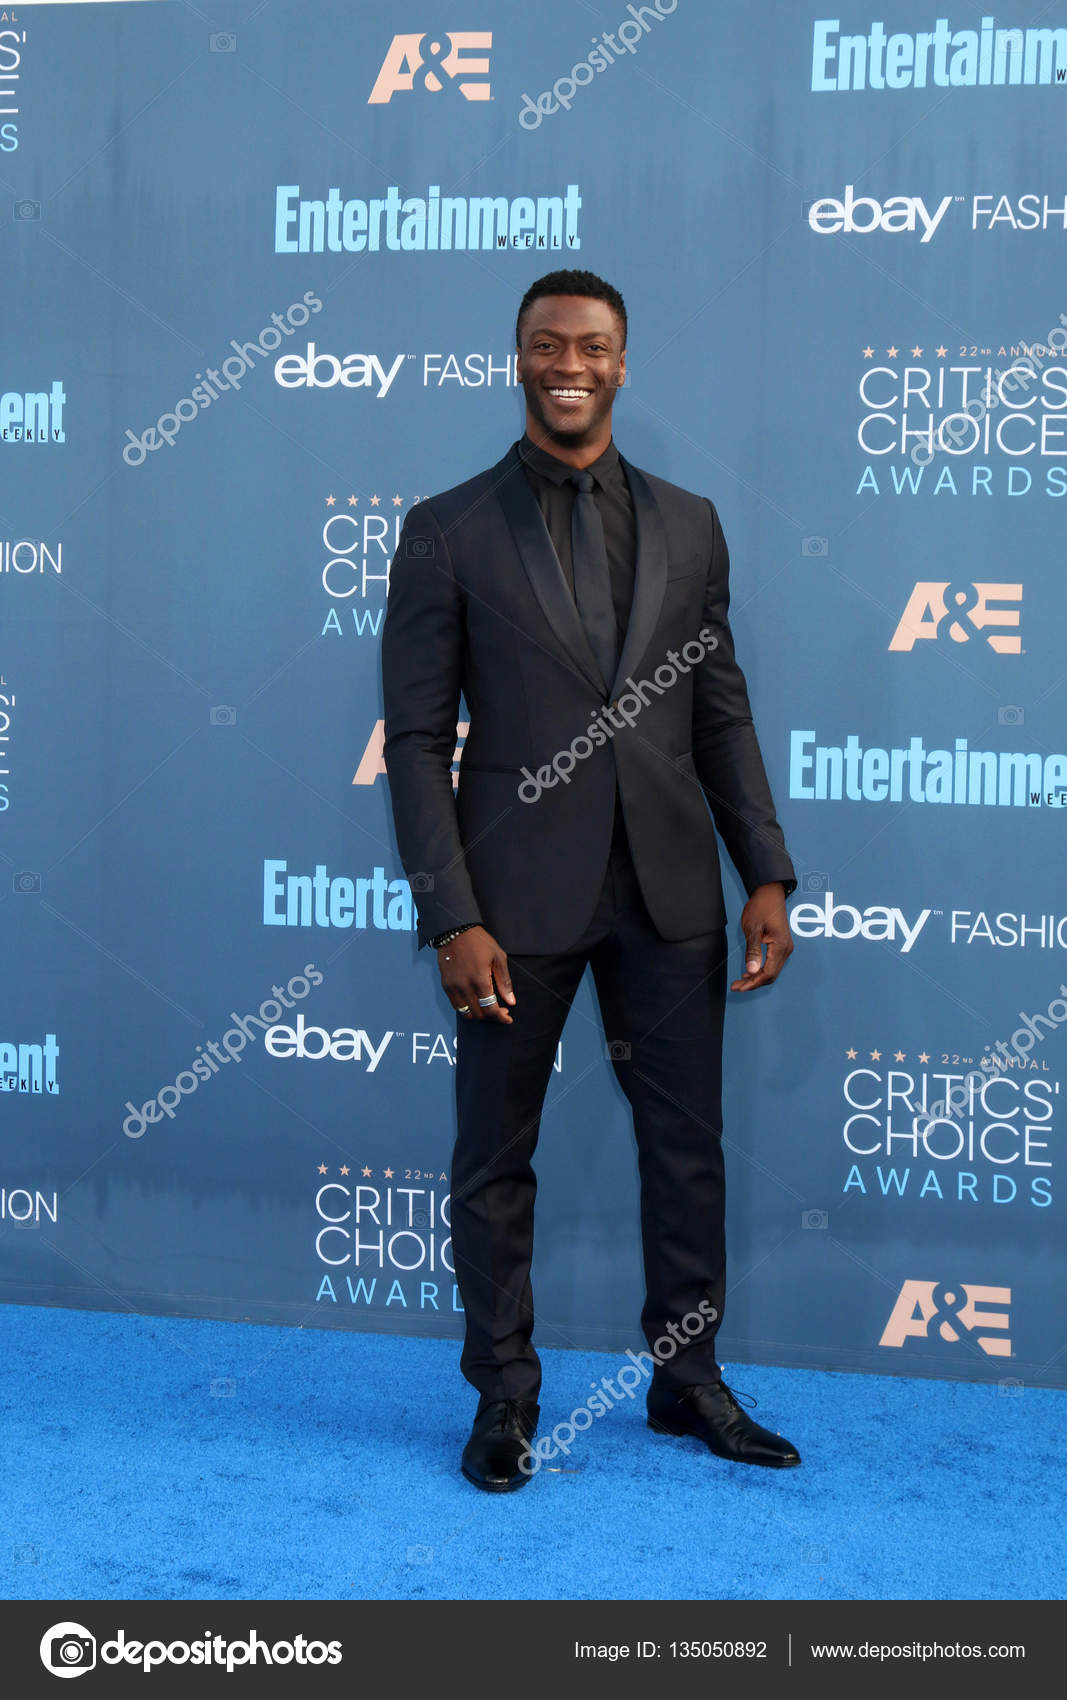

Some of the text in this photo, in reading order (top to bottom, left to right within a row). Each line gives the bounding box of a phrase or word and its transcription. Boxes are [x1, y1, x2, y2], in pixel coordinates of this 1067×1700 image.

[367, 32, 493, 104] A&E
[275, 184, 582, 252] Entertainment
[497, 235, 575, 248] WEEKLY
[808, 185, 952, 243] ebay
[274, 342, 405, 398] ebay
[859, 367, 1067, 410] CRITICS
[857, 413, 1067, 456] CHOICE
[856, 466, 1067, 497] AWARDS
[888, 581, 1023, 655] A&E
[789, 892, 931, 952] ebay
[264, 1014, 394, 1073] ebay
[980, 1056, 1050, 1071] ANNUAL
[843, 1069, 1060, 1121] CRITICS'
[843, 1113, 1053, 1167] CHOICE
[843, 1165, 1053, 1207] AWARDS
[878, 1279, 1012, 1357] A&E
